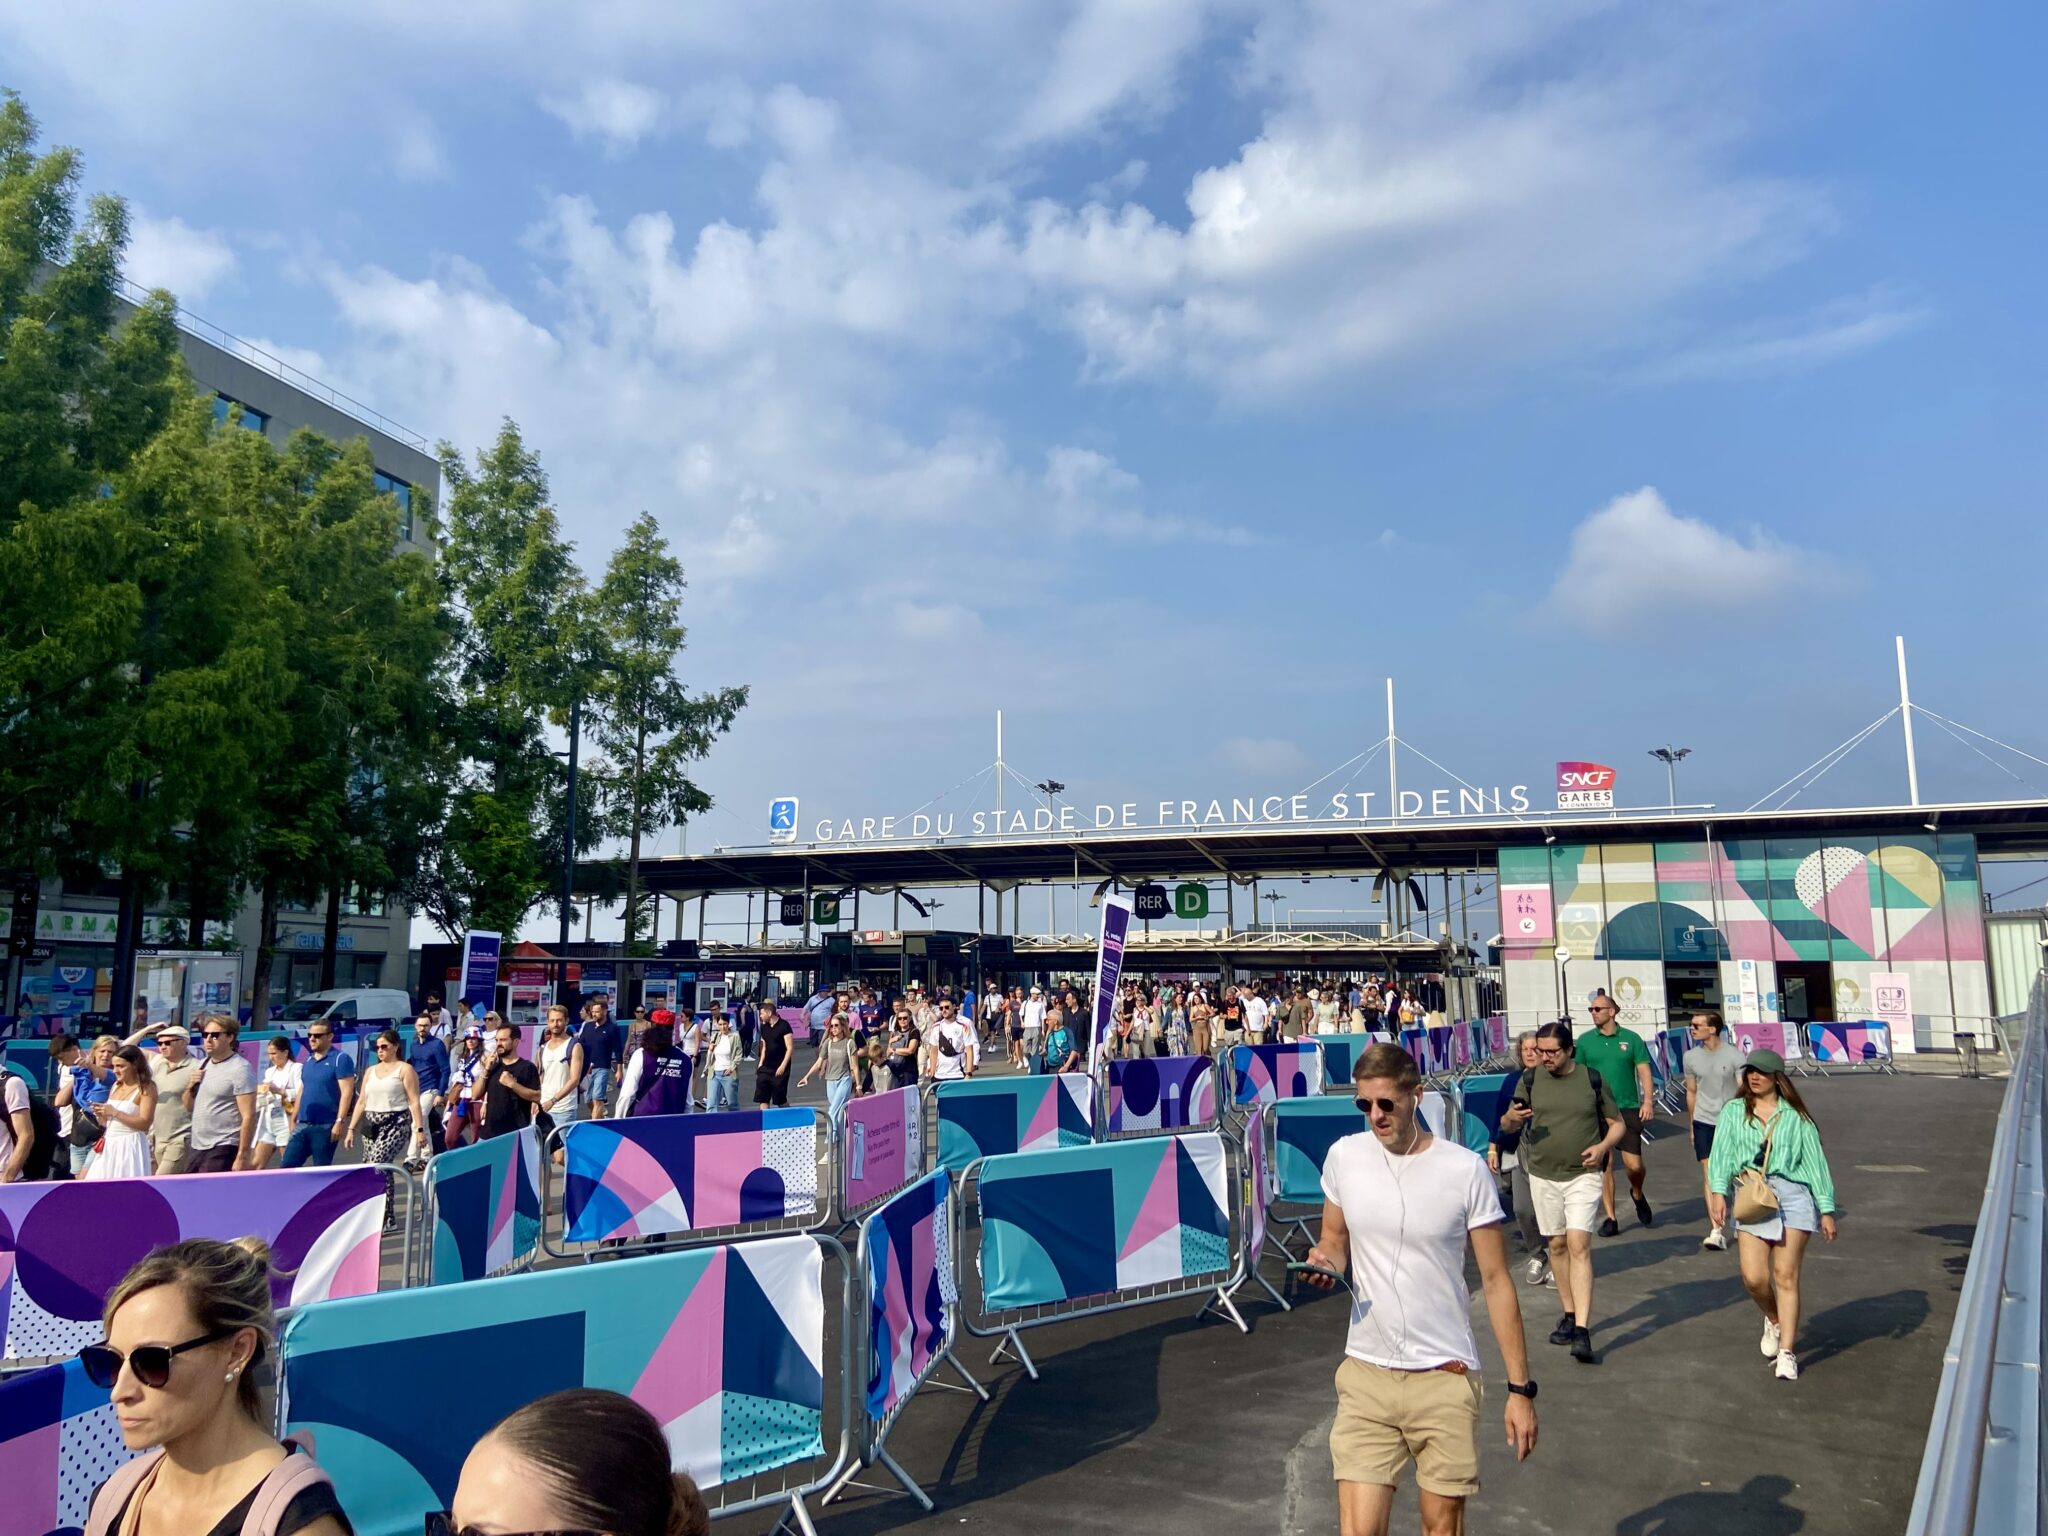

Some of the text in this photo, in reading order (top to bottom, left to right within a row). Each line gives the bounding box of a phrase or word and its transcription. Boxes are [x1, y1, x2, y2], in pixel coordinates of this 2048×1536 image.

[1559, 771, 1612, 787] SNCF
[1559, 792, 1611, 802] GARES
[815, 785, 1530, 842] GARE DU STADE DE FRANCE ST DENIS
[783, 900, 836, 919] RER D
[1138, 891, 1201, 911] RER D
